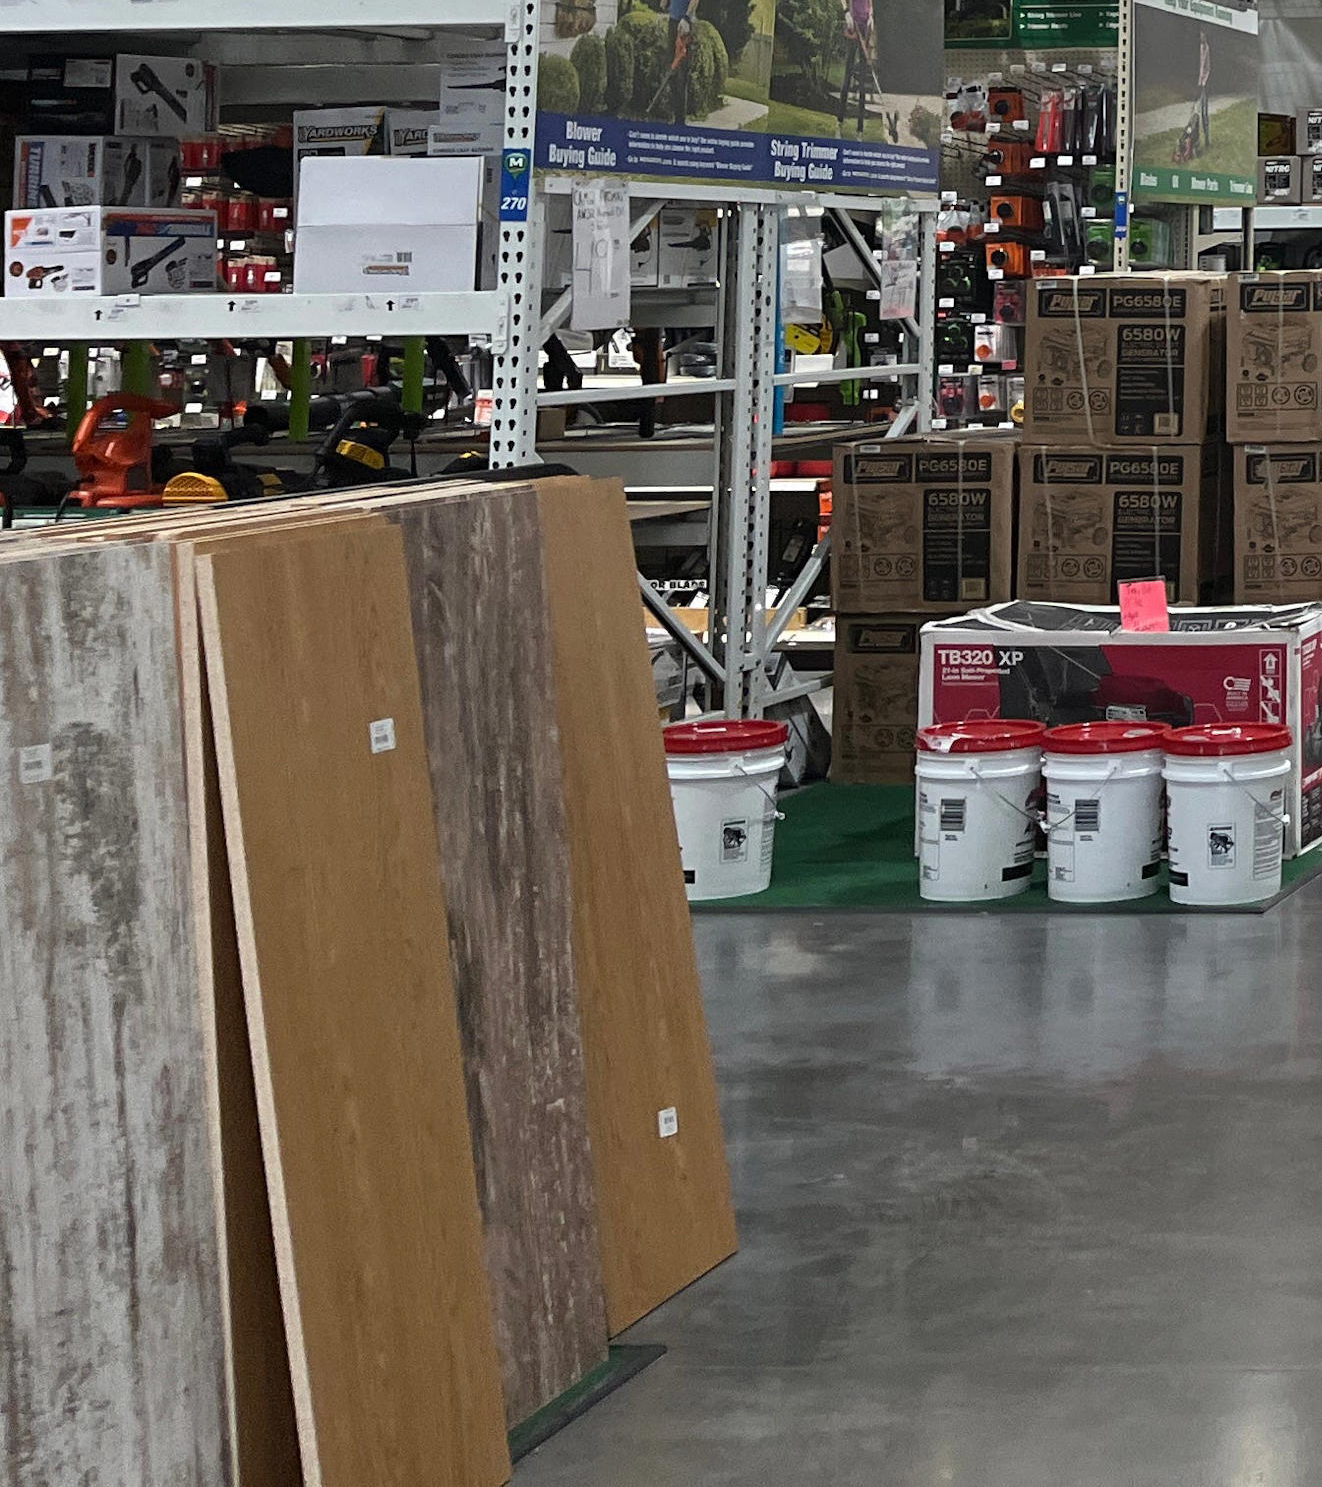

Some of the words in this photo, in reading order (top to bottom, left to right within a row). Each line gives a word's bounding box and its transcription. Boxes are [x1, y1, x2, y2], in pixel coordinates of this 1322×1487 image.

[300, 125, 378, 143] YARDWORKS
[566, 121, 602, 142] Blower
[549, 144, 585, 168] Buying
[588, 147, 617, 167] Guide
[770, 139, 799, 162] String
[801, 141, 839, 161] Trimmer
[774, 161, 806, 182] Buying
[808, 163, 833, 181] Guide
[1265, 165, 1289, 173] NITRO
[501, 197, 526, 210] 270
[1113, 295, 1182, 308] PG6580E
[1122, 328, 1181, 341] 6580W
[1119, 496, 1177, 508] 6580W
[938, 649, 993, 665] TB320
[999, 650, 1024, 666] XP
